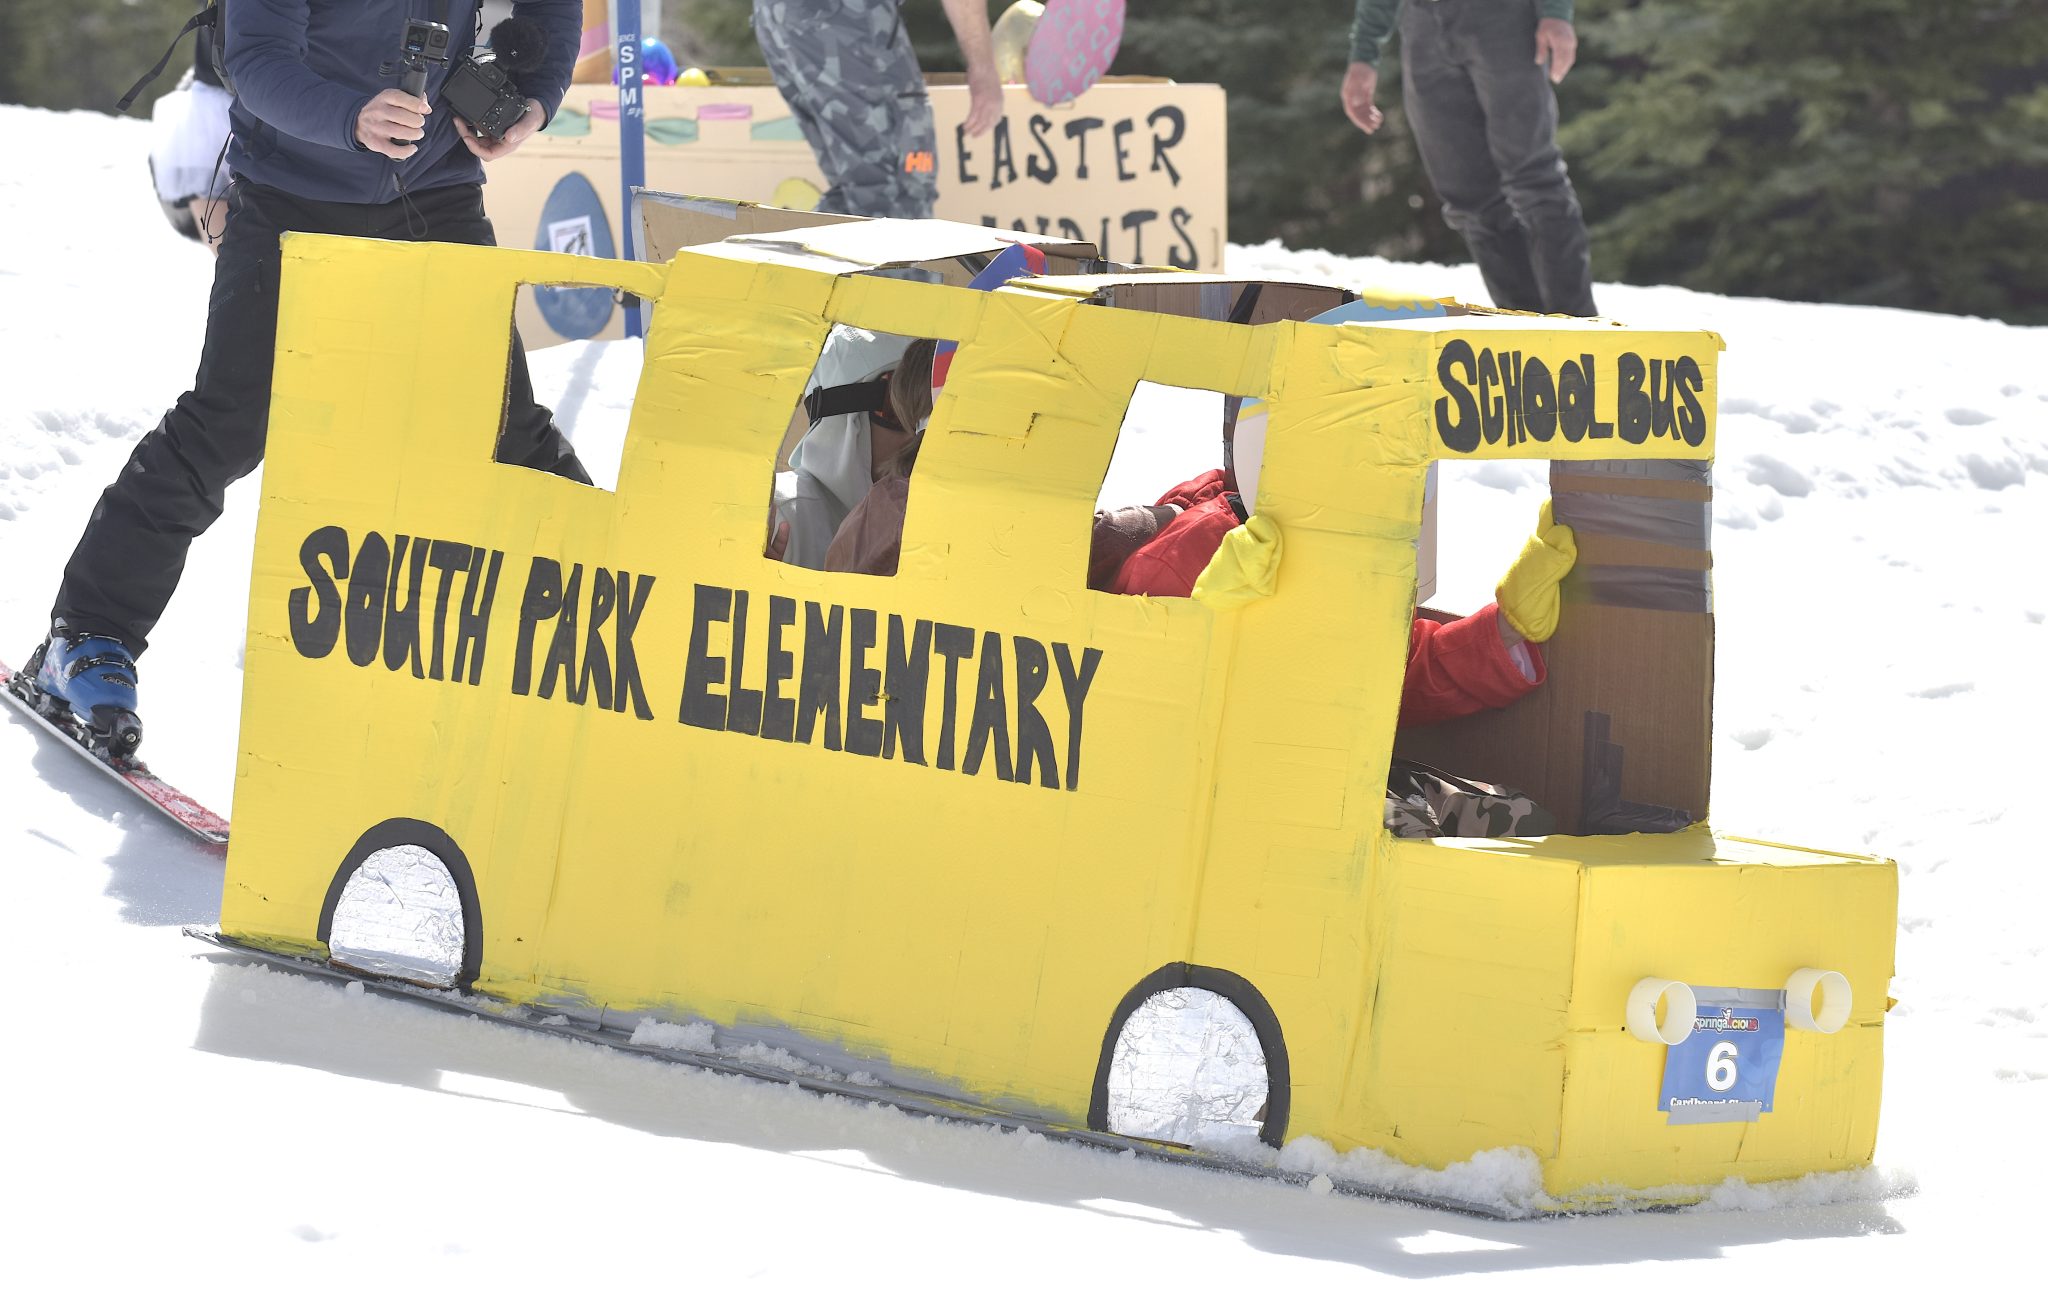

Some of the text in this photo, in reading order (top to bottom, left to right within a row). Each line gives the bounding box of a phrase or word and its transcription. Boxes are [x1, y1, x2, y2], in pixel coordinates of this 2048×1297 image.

[956, 105, 1185, 189] EASTER
[1435, 339, 1706, 453] SCHOOL BUS
[288, 525, 1103, 791] SOUTH PARK ELEMENTARY
[1705, 1040, 1738, 1092] 6
